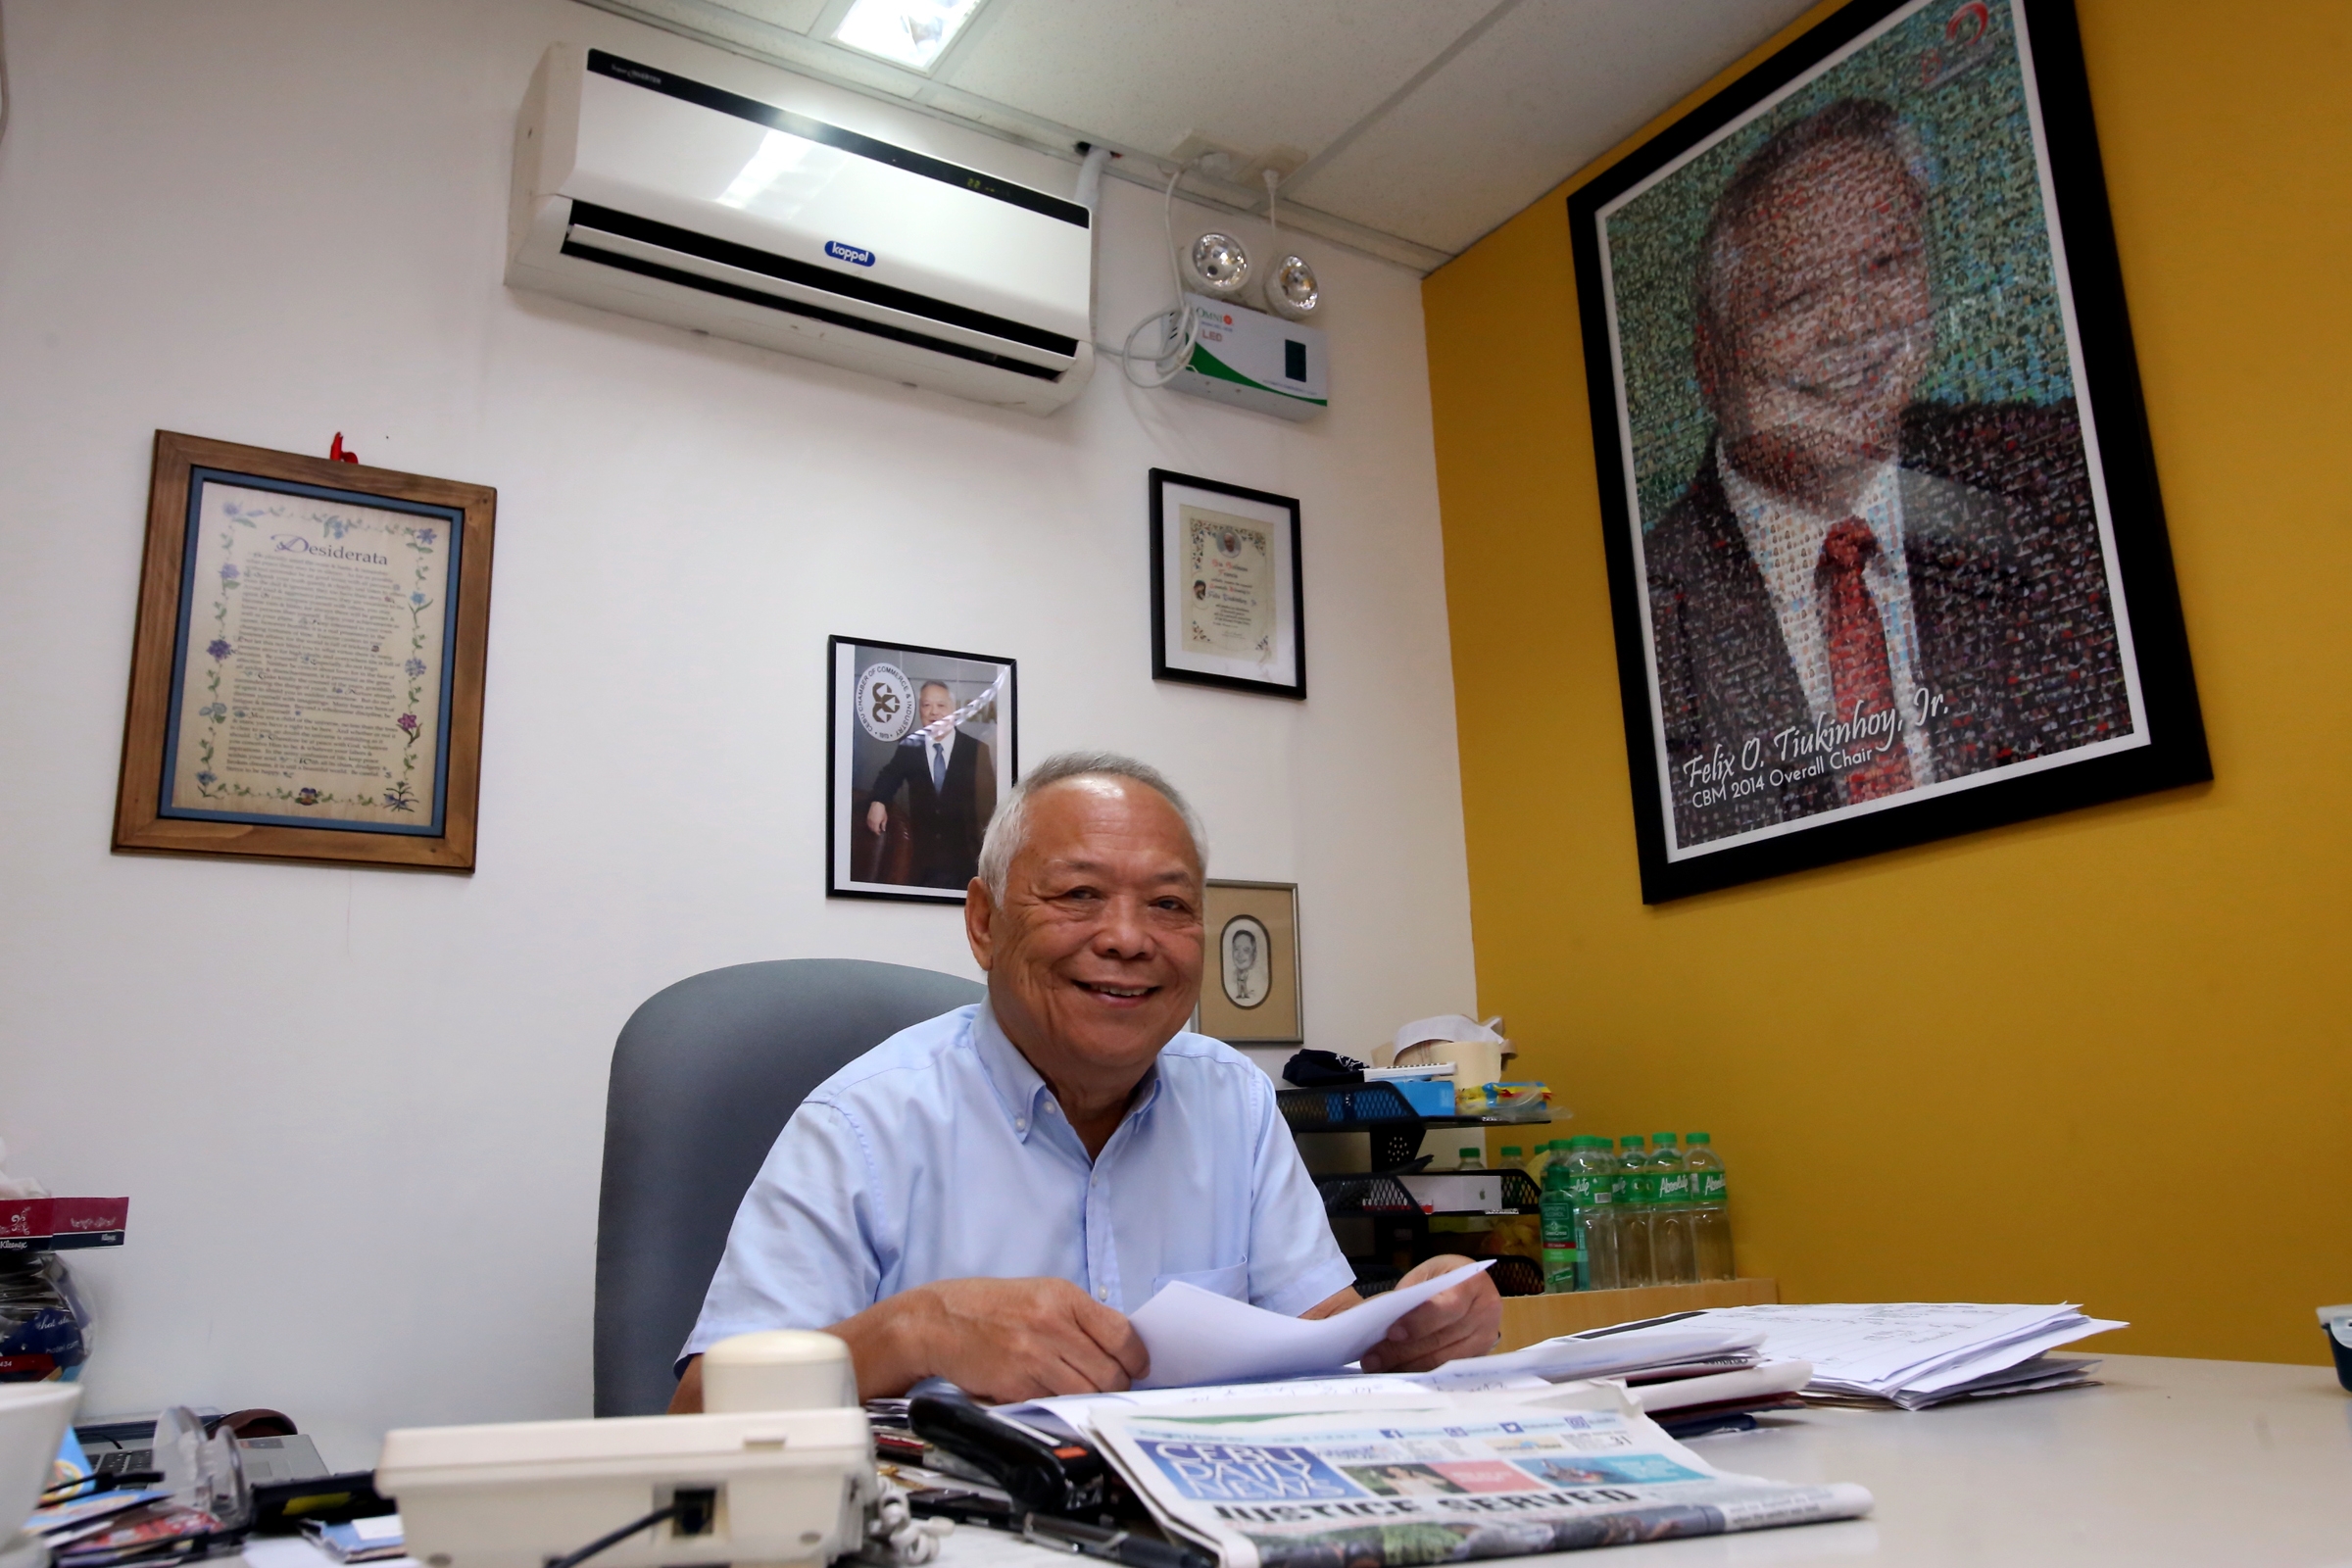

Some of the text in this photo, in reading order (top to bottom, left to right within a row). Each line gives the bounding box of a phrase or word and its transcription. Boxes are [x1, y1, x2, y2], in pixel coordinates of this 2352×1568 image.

[832, 241, 869, 263] koppel
[1196, 307, 1223, 323] OMNI
[1201, 328, 1223, 342] LED
[270, 534, 388, 565] Desiderata
[868, 668, 876, 677] OF
[877, 665, 909, 692] COMMERCE
[858, 675, 869, 712] CHAMBER
[860, 713, 873, 732] CEBU
[895, 701, 912, 737] INDUSTRY
[1683, 744, 1736, 788] Felix
[1773, 699, 1903, 761] Tiukinhoy,
[1914, 687, 1949, 727] Jr.
[1692, 749, 1873, 808] CBM 2014 Overall Chair
[1155, 1443, 1308, 1464] CEBU
[1171, 1460, 1313, 1483] DAILY
[1187, 1476, 1346, 1498] NEWS
[1438, 1488, 1641, 1512] SERVED
